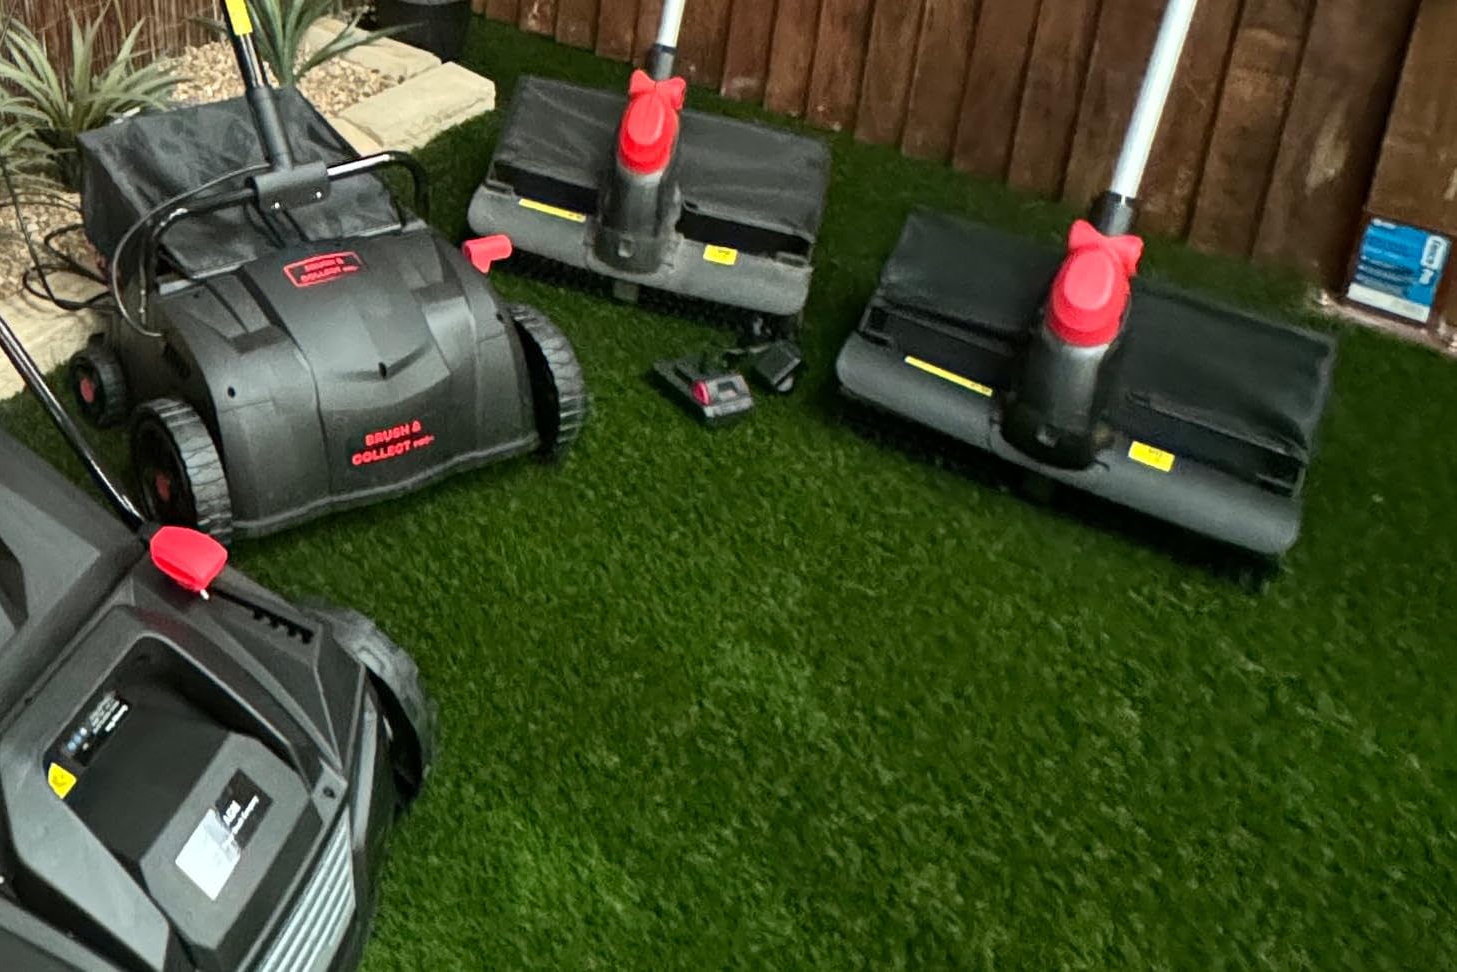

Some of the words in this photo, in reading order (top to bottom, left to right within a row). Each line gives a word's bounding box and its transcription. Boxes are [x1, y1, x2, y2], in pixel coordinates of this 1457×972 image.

[304, 258, 337, 273] BRUSH
[365, 423, 410, 447] BRUSH
[411, 420, 422, 433] &
[351, 440, 411, 466] COLLECT
